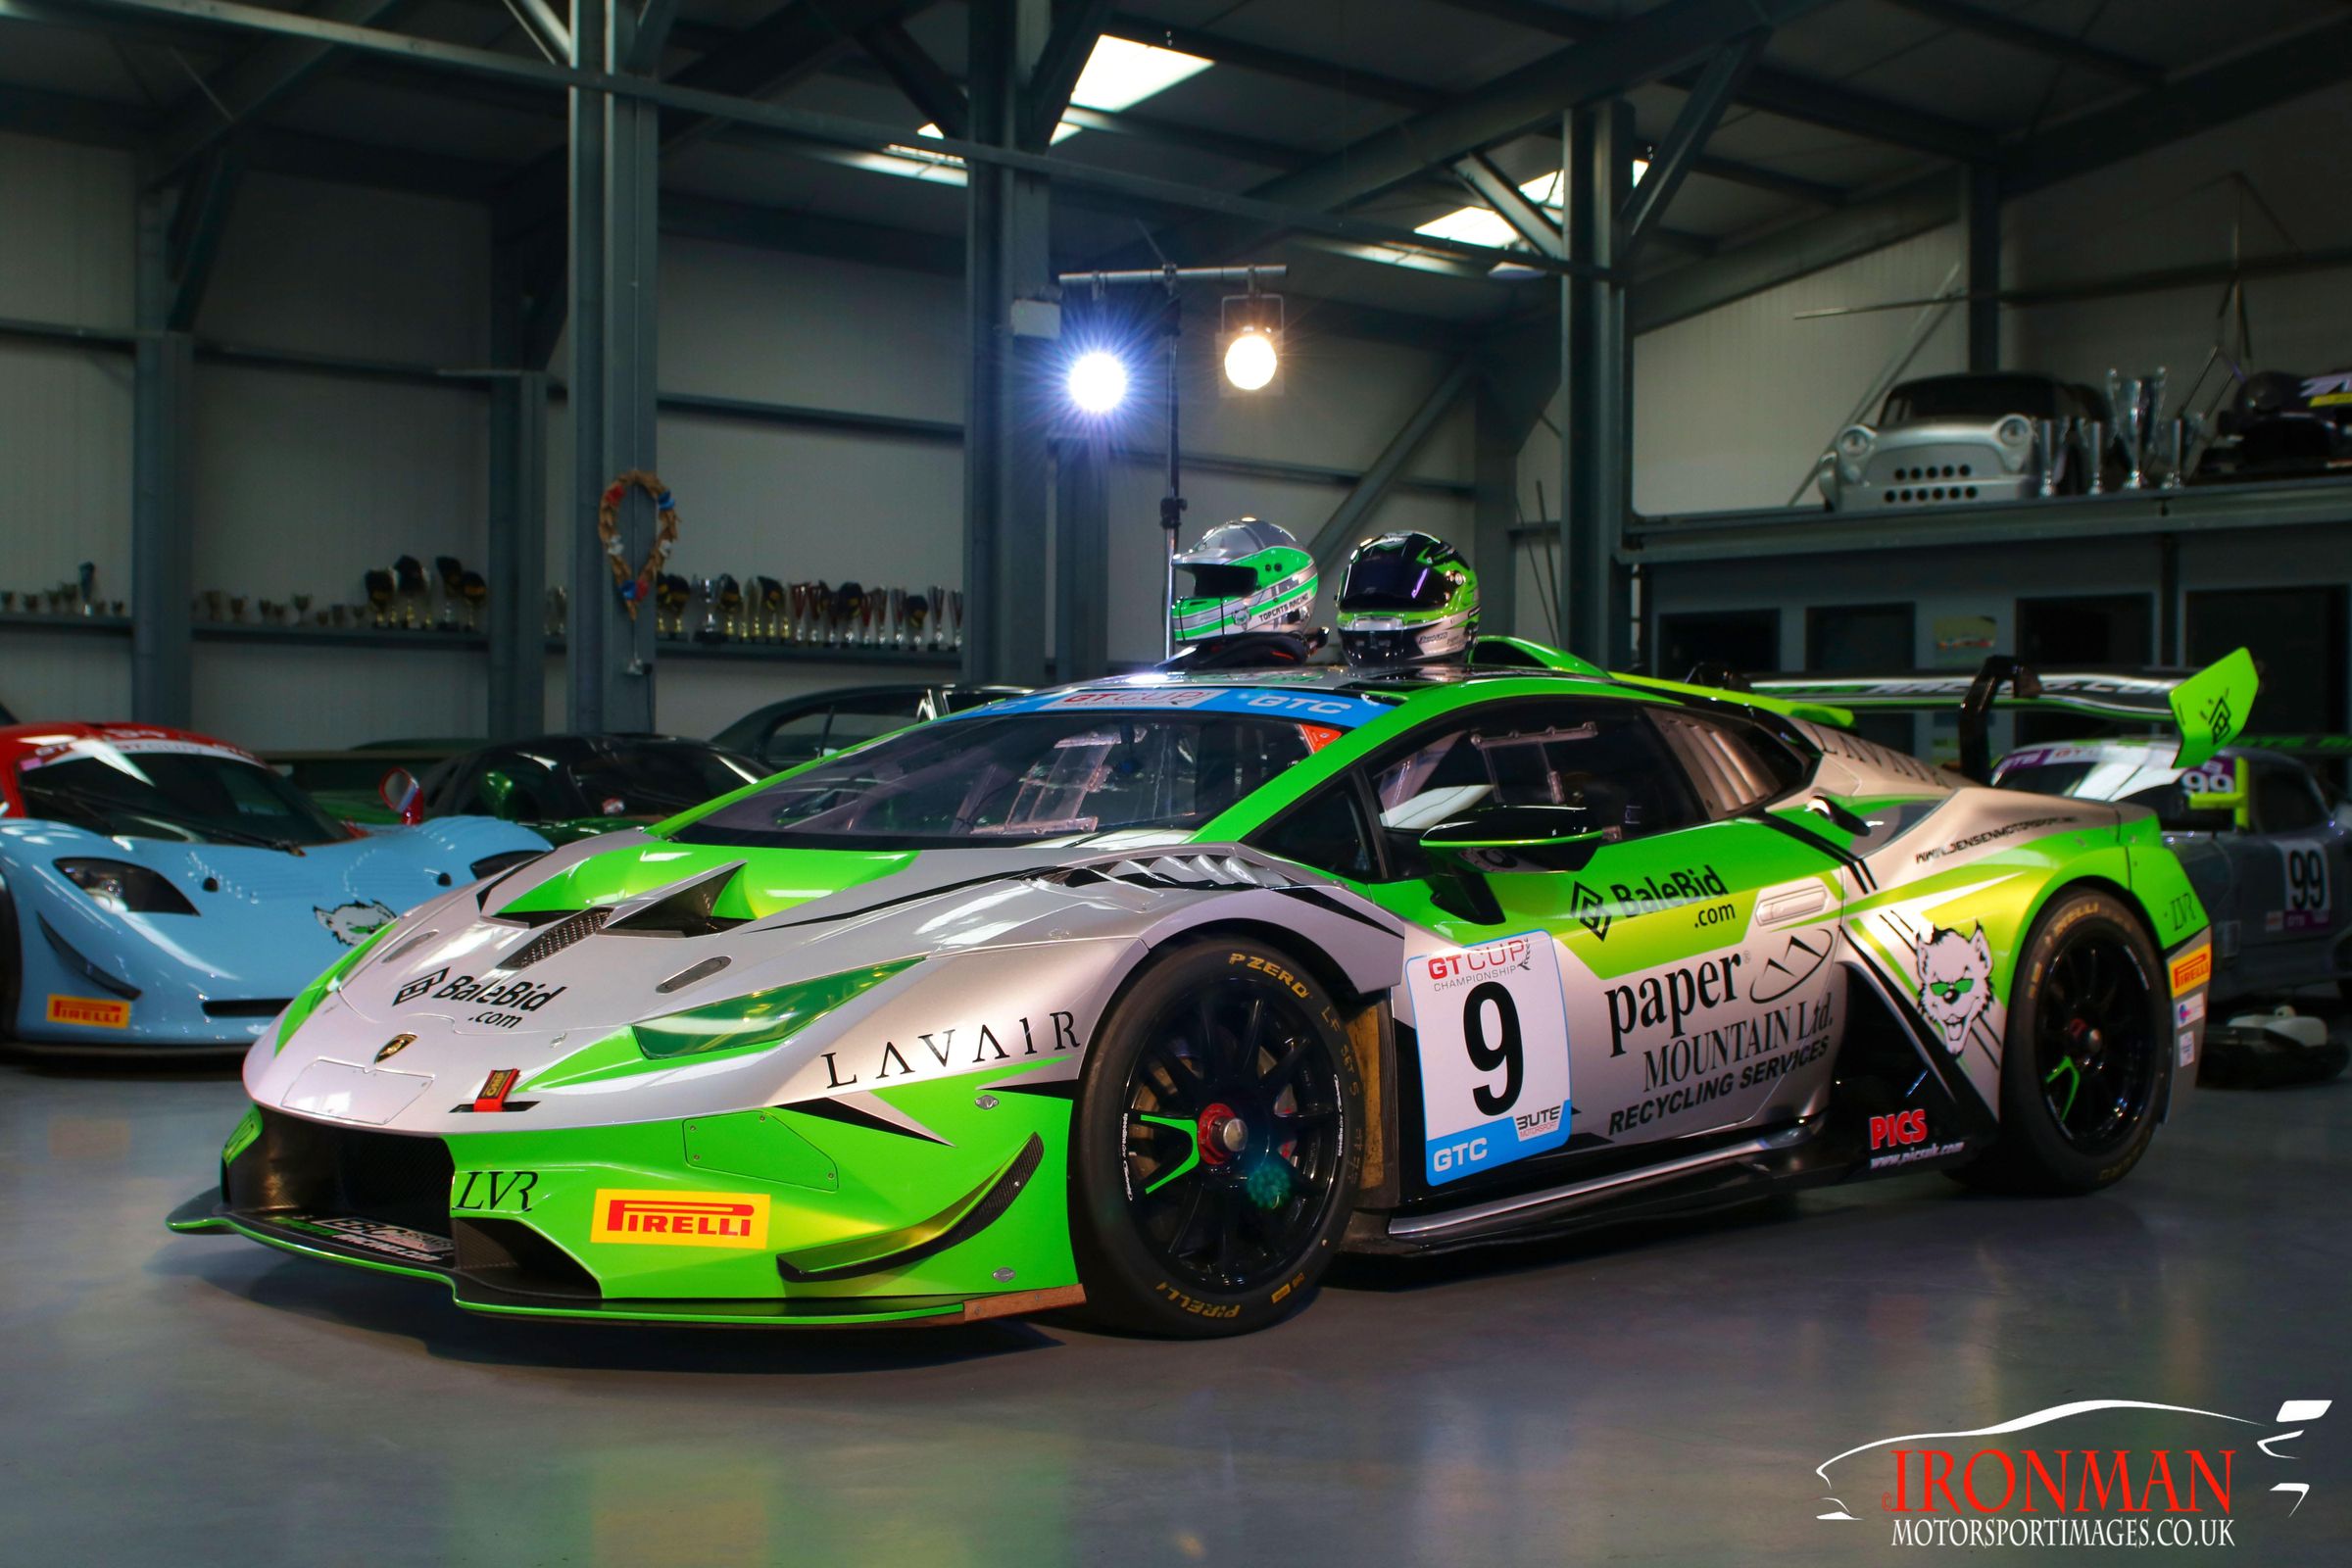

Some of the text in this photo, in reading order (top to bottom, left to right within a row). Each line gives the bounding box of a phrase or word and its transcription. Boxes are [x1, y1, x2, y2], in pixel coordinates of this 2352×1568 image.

[1064, 692, 1120, 703] GT
[1248, 695, 1353, 714] GTC
[1609, 864, 1731, 918] BaleBid
[2289, 849, 2325, 910] 99
[1694, 903, 1737, 929] .com
[1247, 956, 1310, 999] ZERO
[1428, 939, 1526, 981] GT CUP
[1433, 965, 1517, 993] CHAMPIONSHIP
[2174, 952, 2210, 990] PIRELLI
[53, 1001, 122, 1023] PIRELLI
[431, 975, 567, 1012] BaleBid
[1604, 952, 1741, 1057] paper
[467, 1011, 523, 1029] .com
[821, 1010, 1081, 1089] LAVAIR
[1463, 981, 1525, 1116] 9
[1642, 991, 1834, 1093] MOUNTAIN Ltd.
[1608, 1034, 1831, 1137] RECYCLING SERVICES
[1516, 1104, 1561, 1131] BUTE
[1519, 1120, 1559, 1139] MOTORSPORT
[1869, 1108, 1928, 1151] PICS
[1433, 1136, 1489, 1173] GTC
[452, 1170, 539, 1213] LVR
[607, 1199, 755, 1238] PIRELLI
[1155, 1280, 1242, 1318] PIRELLI
